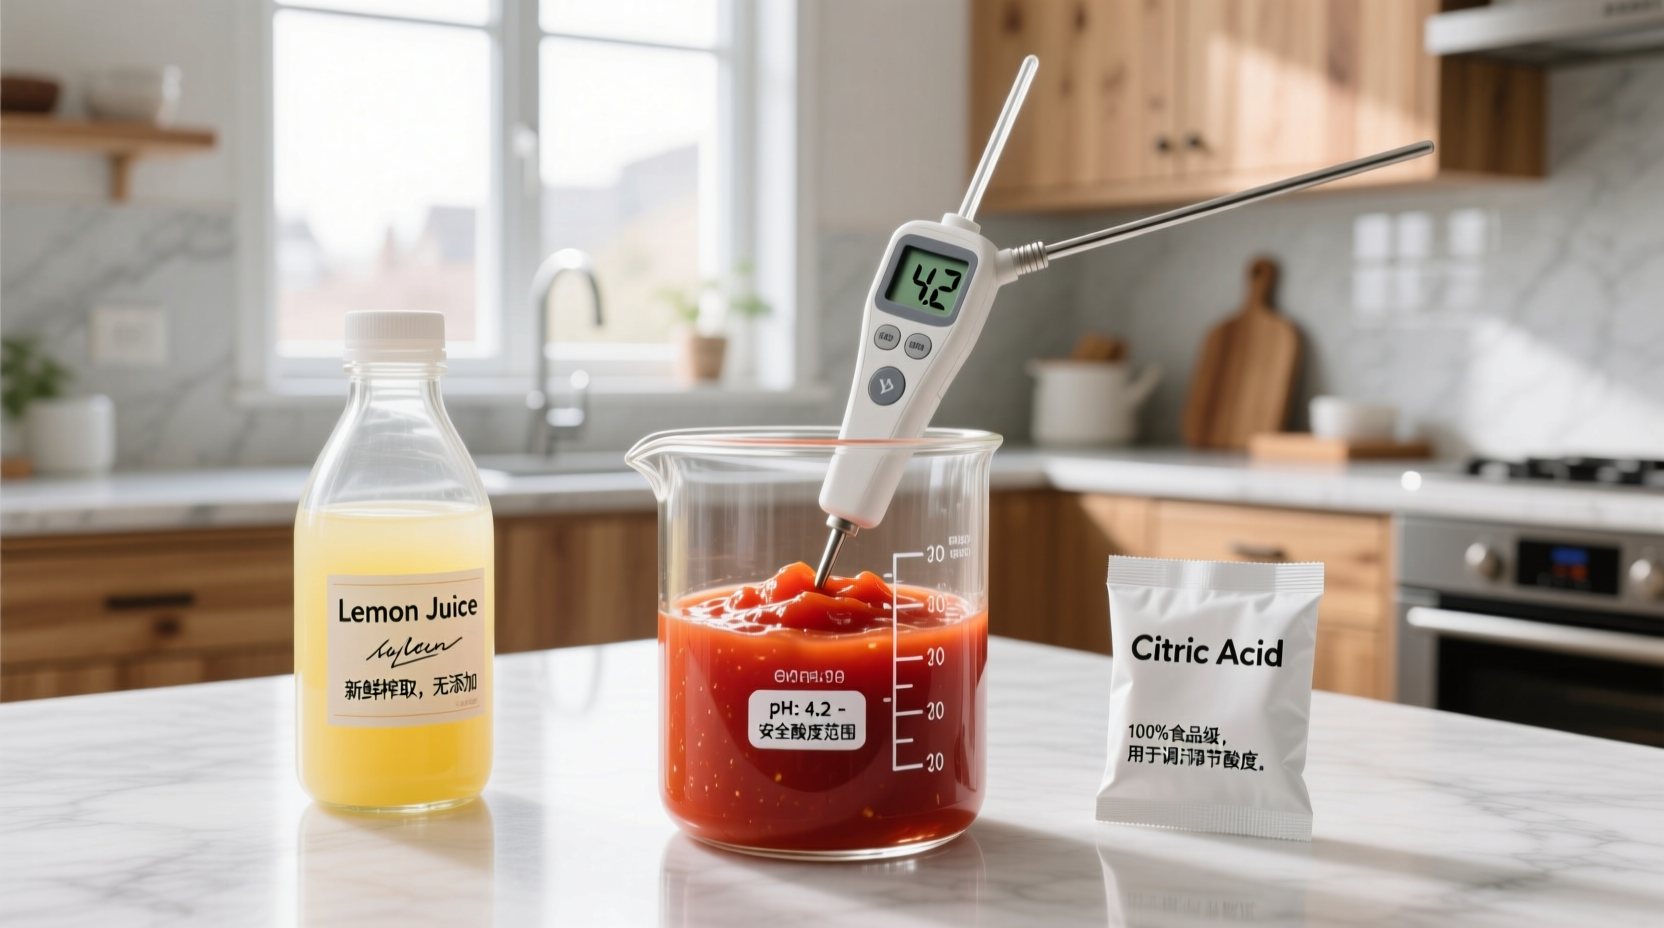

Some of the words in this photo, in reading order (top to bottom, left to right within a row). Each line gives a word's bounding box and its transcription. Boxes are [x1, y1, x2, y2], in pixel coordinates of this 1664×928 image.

[913, 264, 962, 311] 4.2
[339, 598, 418, 623] Lemon
[426, 594, 478, 620] Juice
[1131, 634, 1210, 664] Citric
[1215, 638, 1284, 668] Acid
[769, 700, 799, 720] pH:
[804, 701, 832, 717] 4.2
